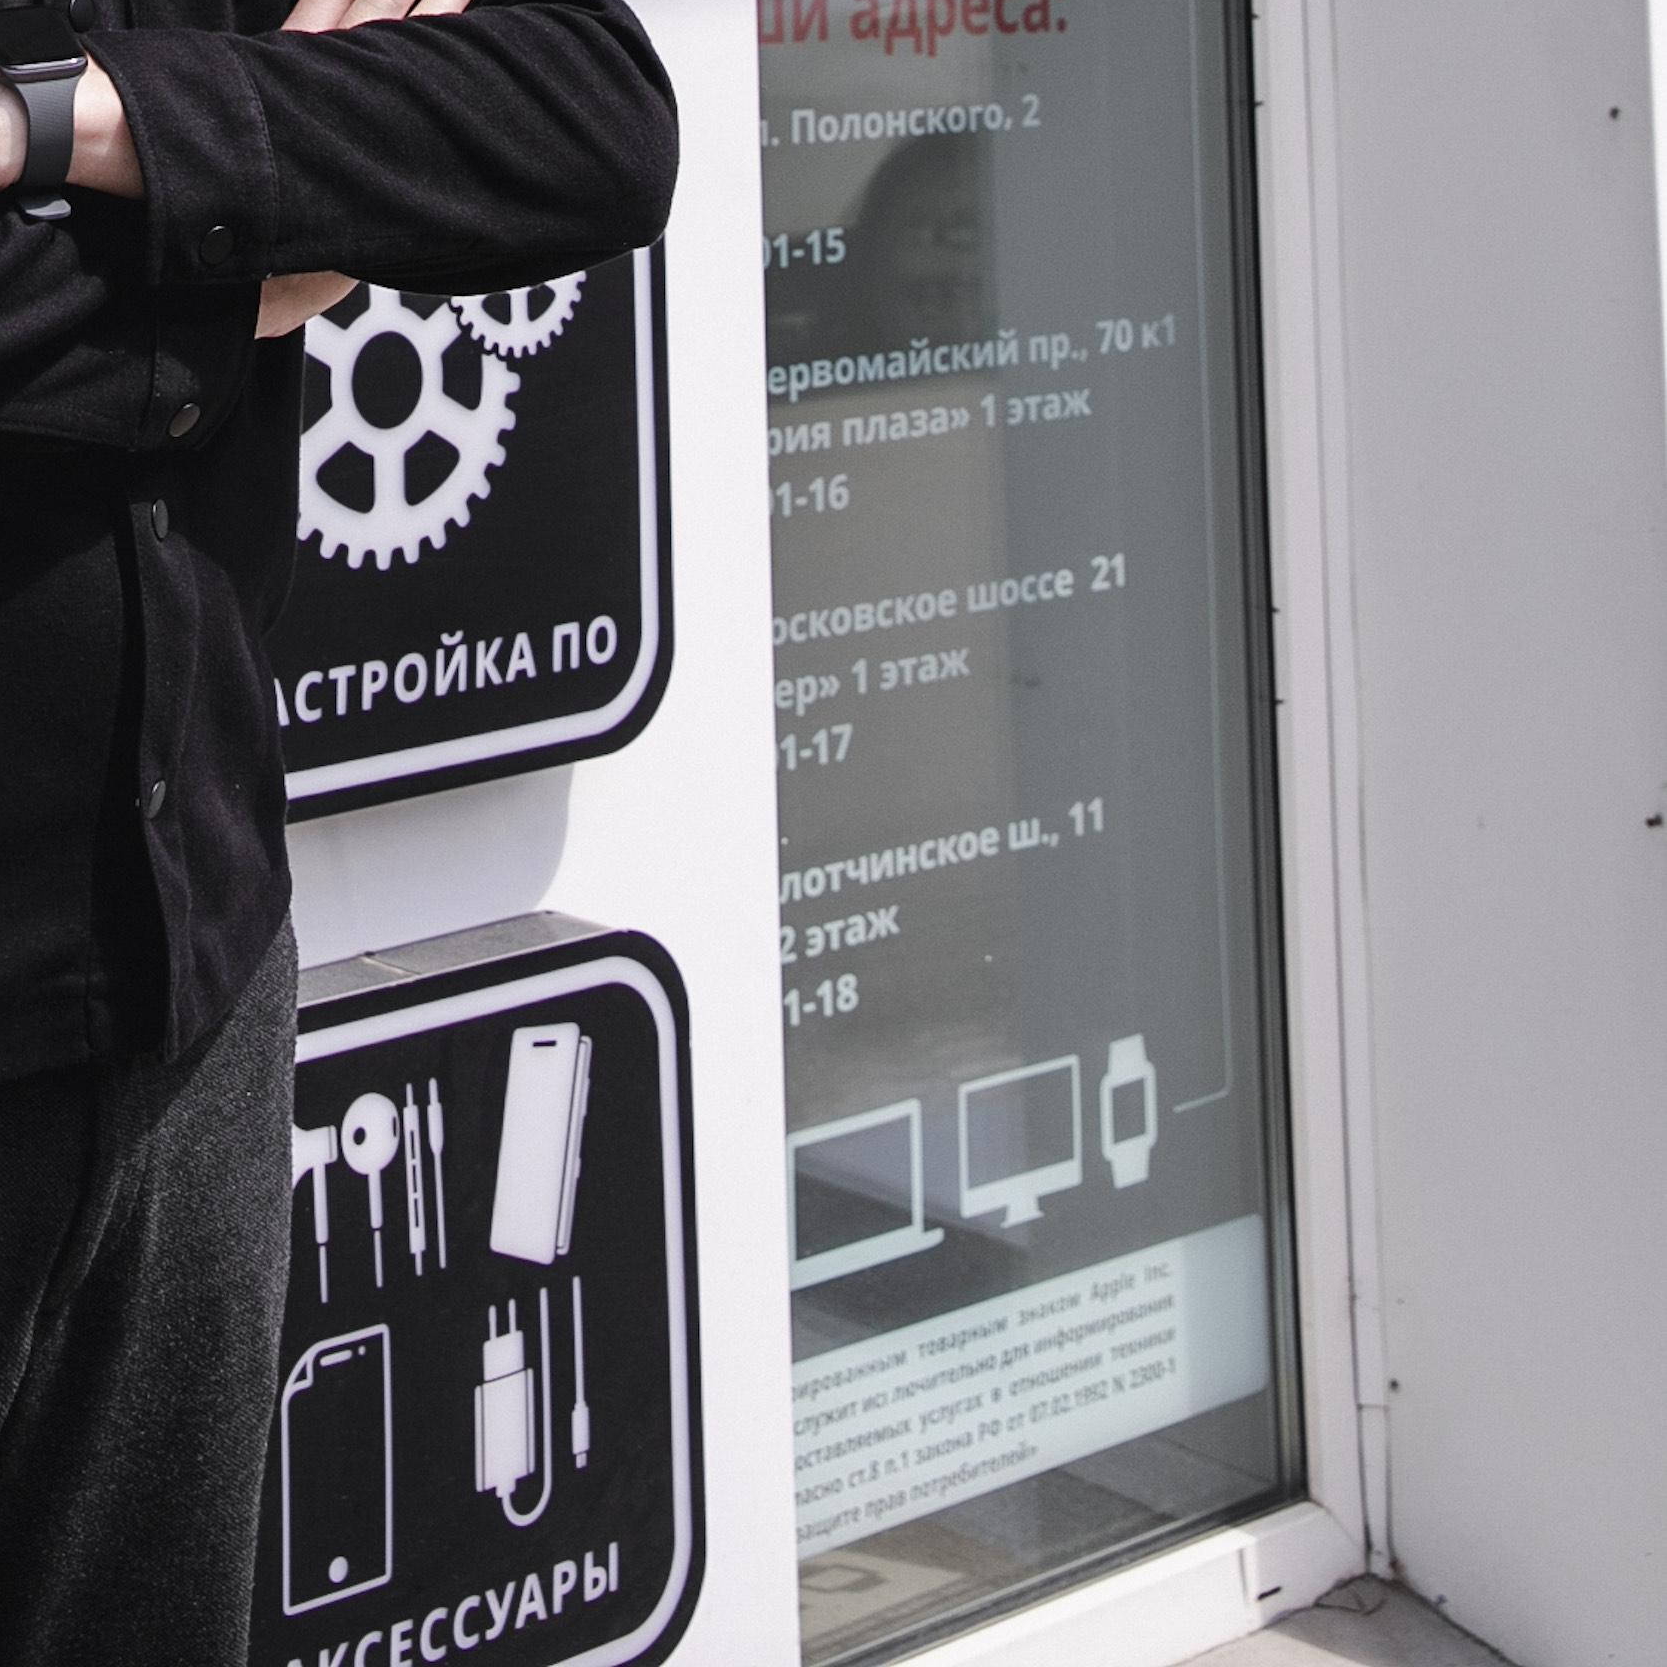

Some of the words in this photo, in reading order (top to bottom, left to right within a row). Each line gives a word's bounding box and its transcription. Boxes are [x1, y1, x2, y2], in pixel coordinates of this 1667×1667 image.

[791, 102, 1013, 145] Полонского,
[1021, 93, 1042, 128] 2
[1029, 332, 1089, 371] пр.,
[1096, 317, 1134, 354] 70
[842, 406, 971, 448] плаза»
[980, 393, 996, 427] 1
[1006, 388, 1092, 426] этаж
[769, 473, 850, 517] 1-16
[966, 568, 1075, 614] шоссе
[1090, 552, 1127, 593] 21
[551, 614, 619, 672] ПО
[851, 658, 868, 695] 1
[879, 647, 971, 691] этаж
[776, 723, 854, 771] 1-17
[780, 826, 1001, 905] лотчинское
[1008, 817, 1060, 851] ш.,
[1067, 796, 1104, 837] 11
[780, 924, 798, 966] 2
[805, 904, 901, 958] этаж
[286, 1541, 620, 1667] СЕССУАРЫ
